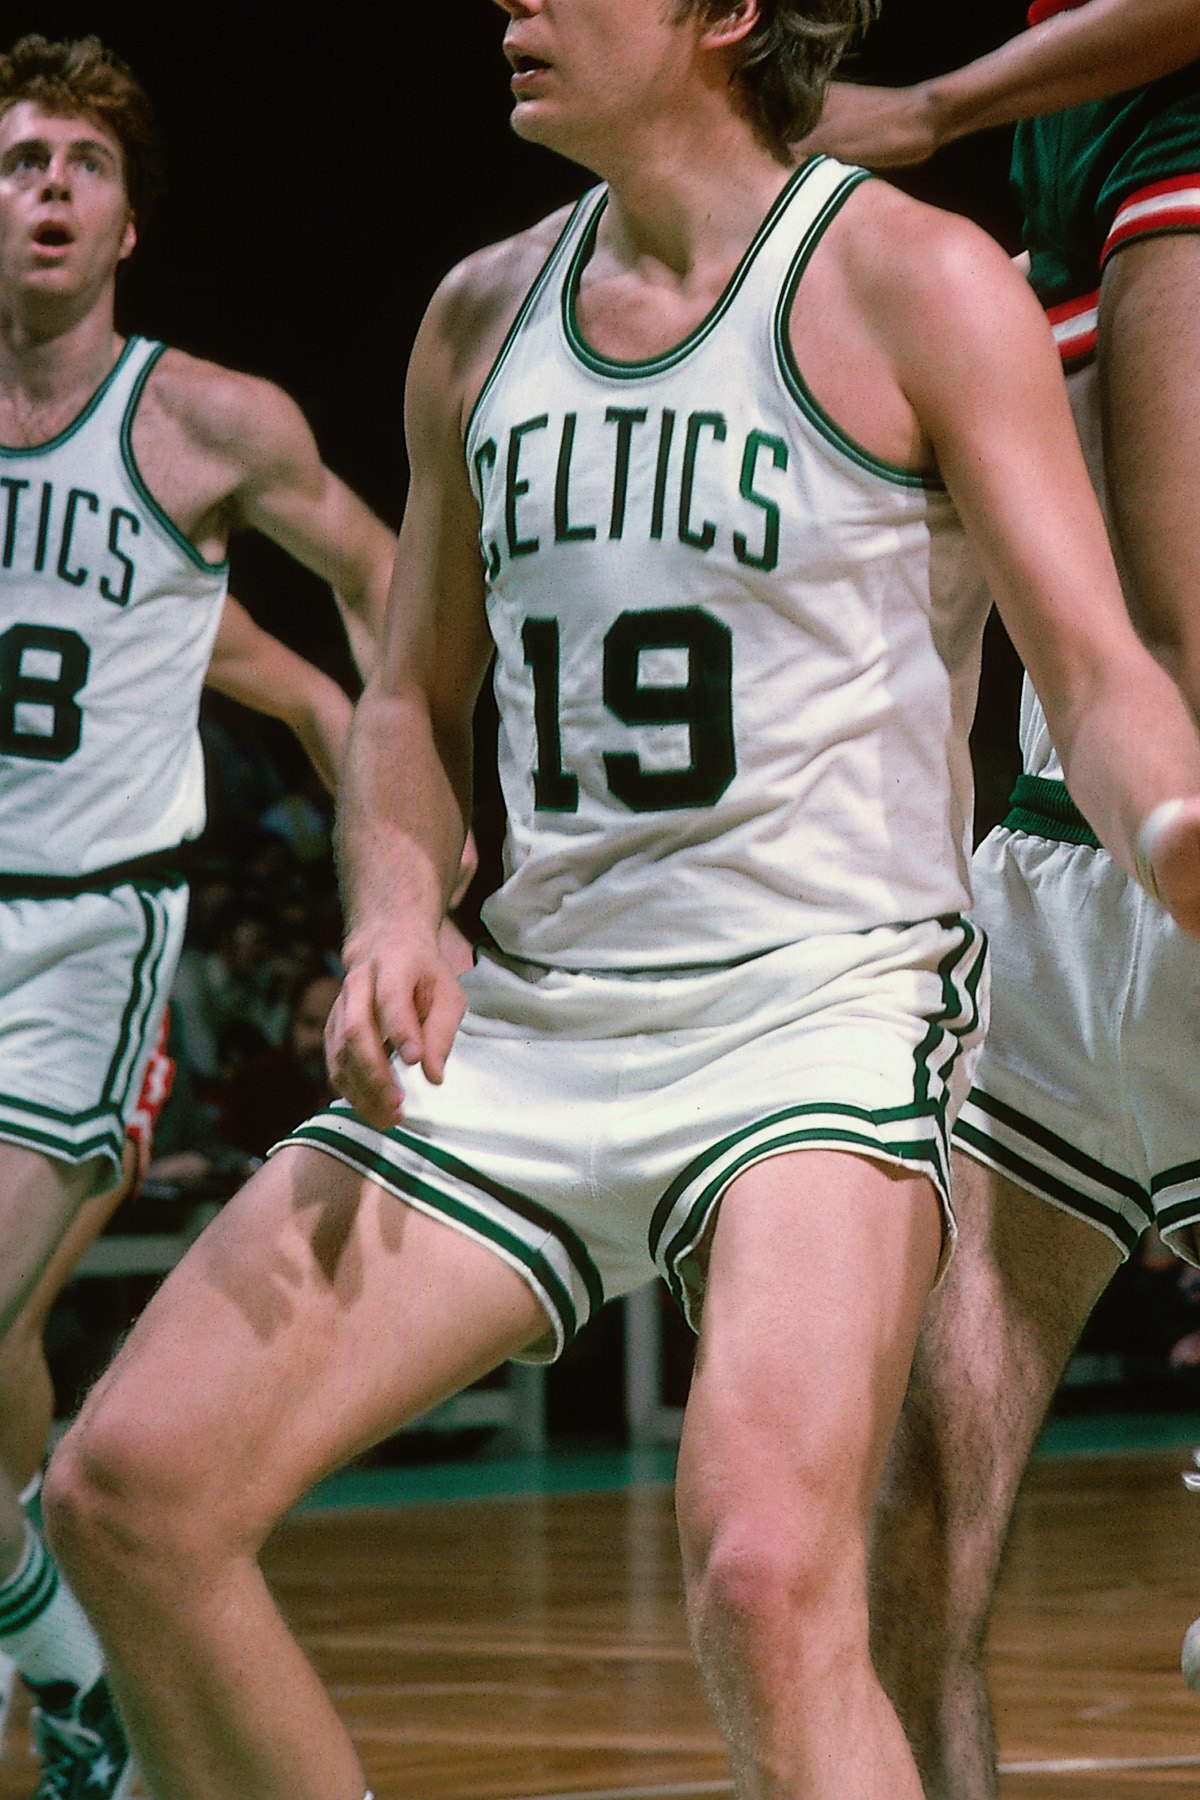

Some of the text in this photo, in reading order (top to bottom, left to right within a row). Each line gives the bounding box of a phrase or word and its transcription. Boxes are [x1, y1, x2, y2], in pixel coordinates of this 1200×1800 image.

[474, 406, 790, 582] CELTICS
[0, 622, 91, 763] 8
[521, 604, 738, 814] 19
